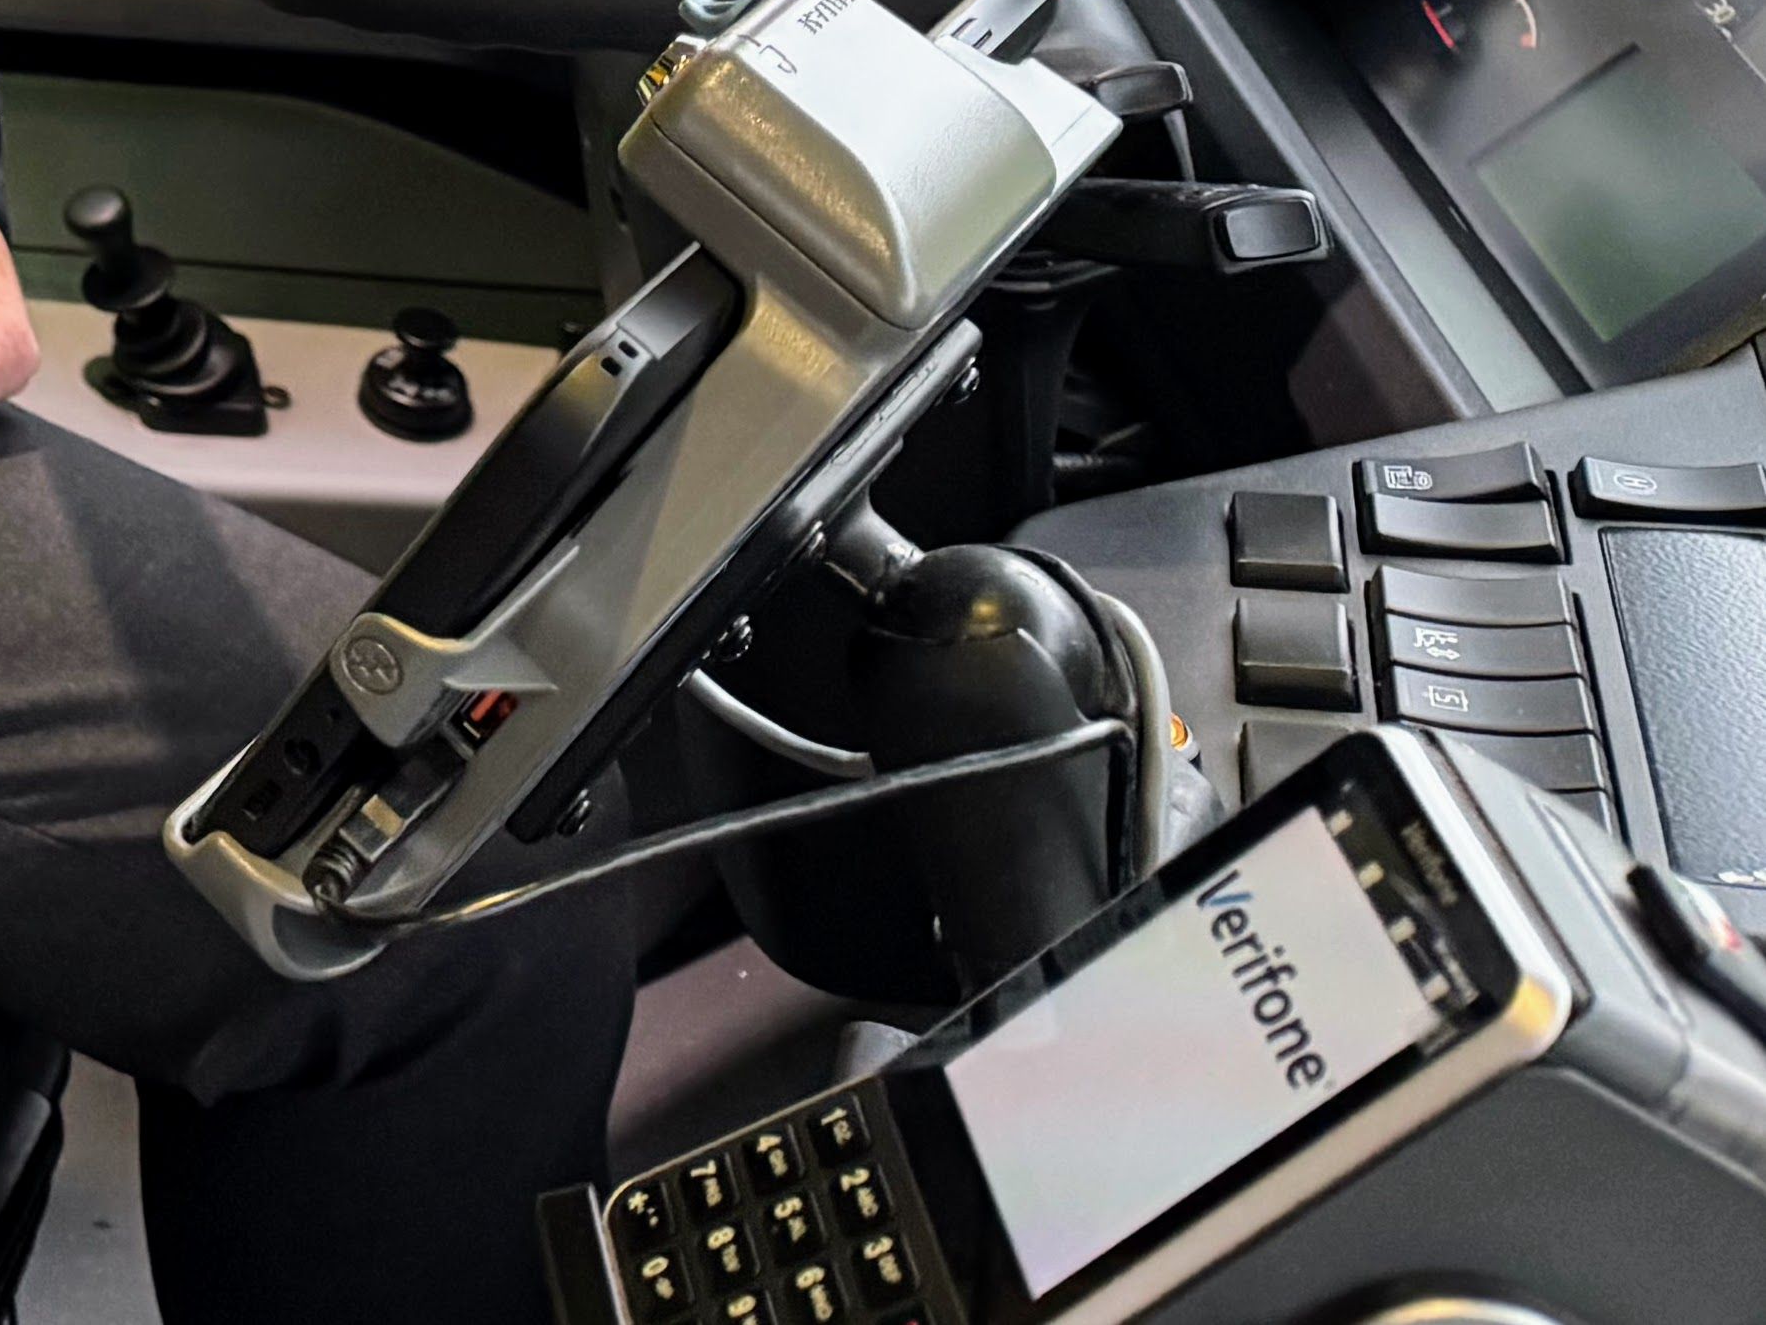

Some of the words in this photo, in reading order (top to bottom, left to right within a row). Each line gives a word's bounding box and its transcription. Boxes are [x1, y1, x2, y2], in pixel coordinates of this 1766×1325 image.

[1196, 869, 1326, 1090] Verifone
[820, 1108, 848, 1126] 1
[756, 1134, 783, 1153] 4
[690, 1159, 717, 1177] 7
[840, 1168, 869, 1192] 2
[773, 1197, 803, 1220] 5
[707, 1226, 735, 1249] 8
[863, 1236, 893, 1260] 3
[642, 1256, 669, 1278] 0
[796, 1265, 826, 1290] 6
[728, 1295, 756, 1318] 9
